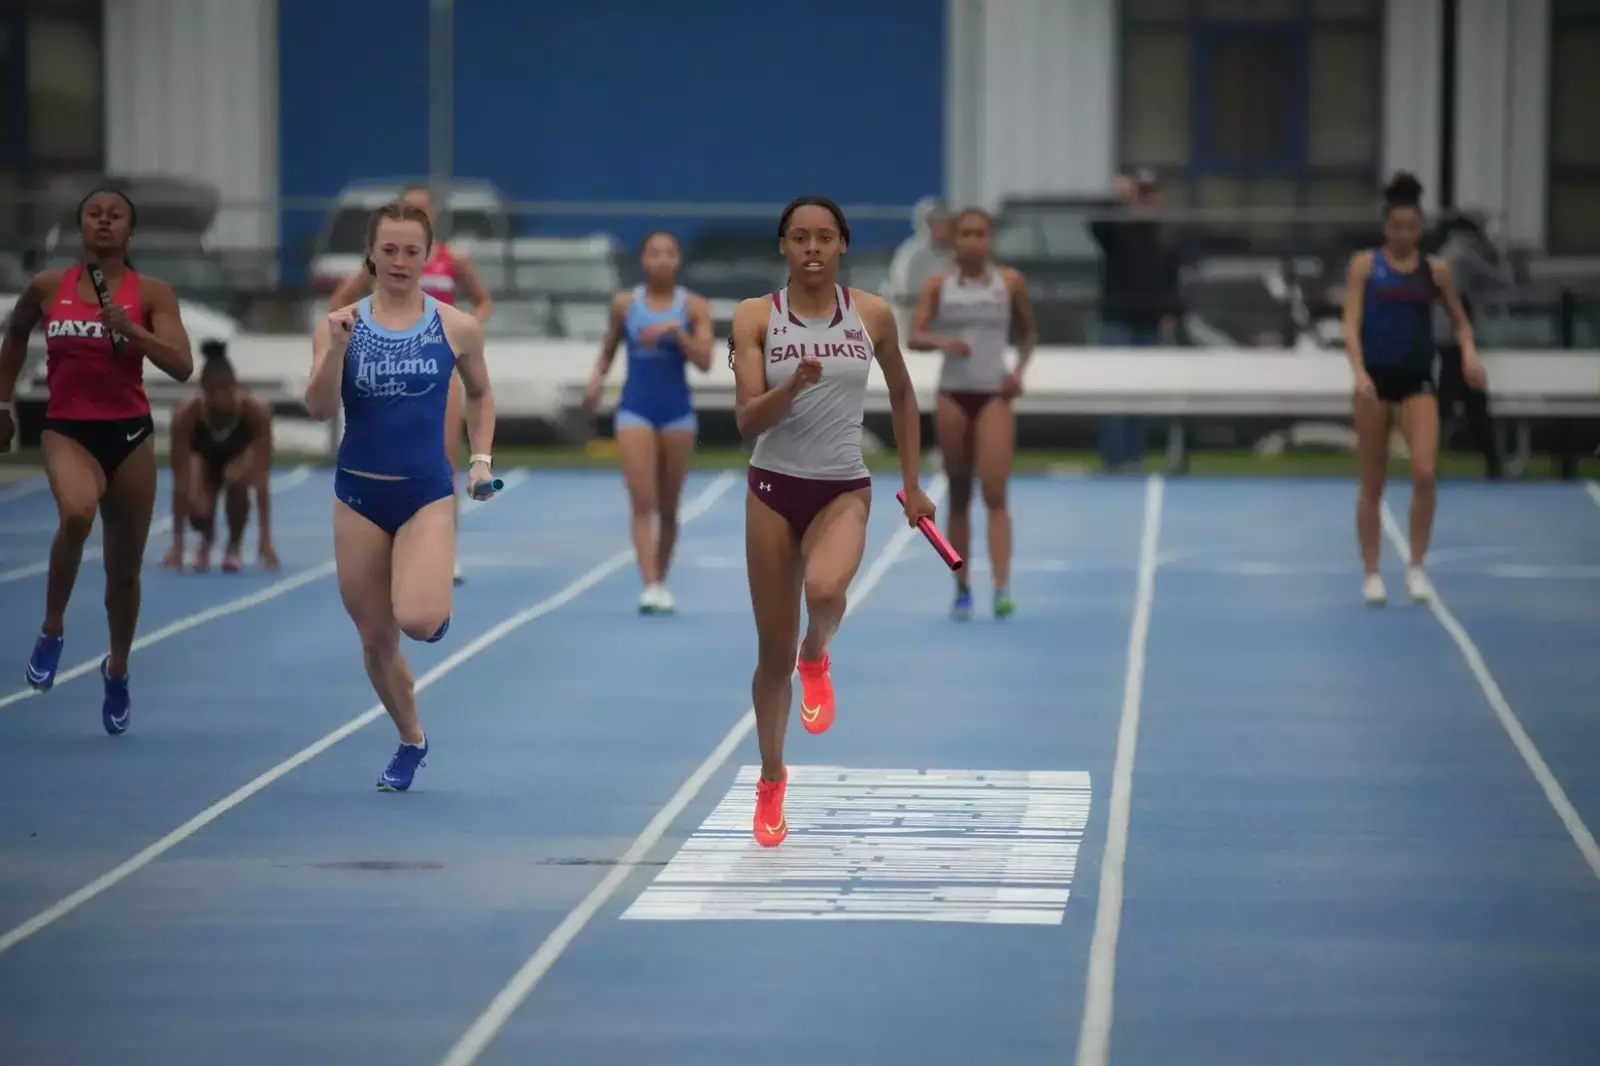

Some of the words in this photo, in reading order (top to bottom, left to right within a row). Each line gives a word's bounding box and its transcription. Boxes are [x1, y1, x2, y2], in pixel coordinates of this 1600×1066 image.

[48, 320, 128, 342] DAYT
[770, 343, 867, 364] SALUKIS
[356, 352, 439, 378] Indiana
[355, 376, 436, 397] State
